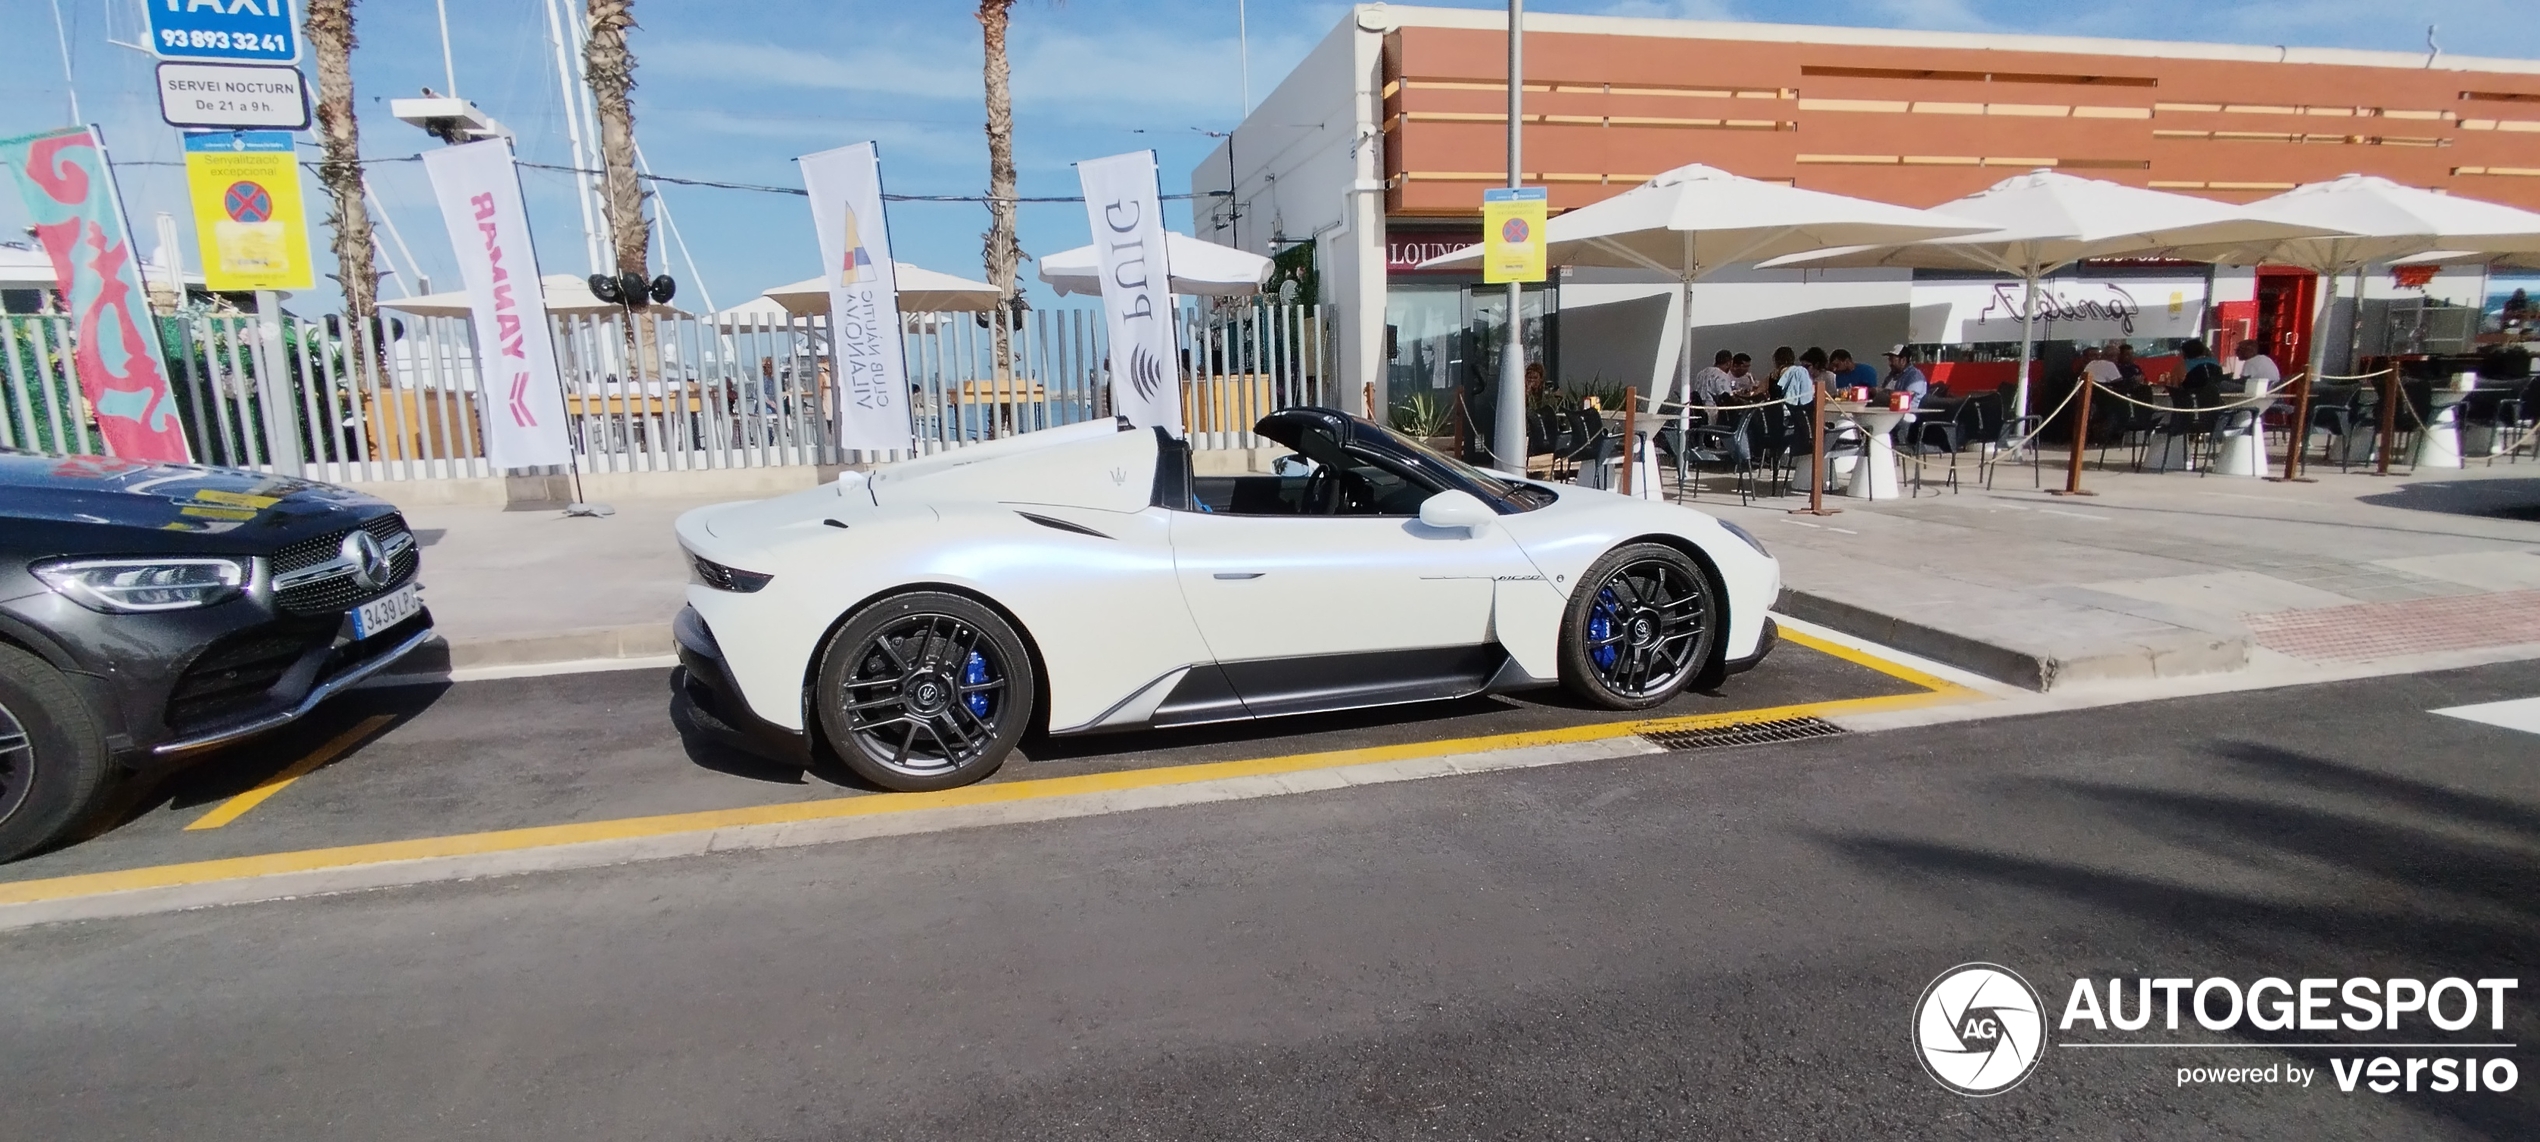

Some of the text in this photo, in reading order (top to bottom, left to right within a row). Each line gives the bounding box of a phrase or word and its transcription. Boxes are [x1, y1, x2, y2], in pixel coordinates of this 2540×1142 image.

[161, 29, 286, 52] 93 893 32 41
[168, 80, 294, 94] SERVEI NOCTURN
[195, 100, 214, 110] De
[218, 101, 234, 111] 21
[240, 103, 247, 111] a
[204, 155, 280, 166] Senyalització
[210, 168, 277, 177] excepcional
[1390, 242, 1480, 265] LOUN
[364, 599, 397, 631] 3439
